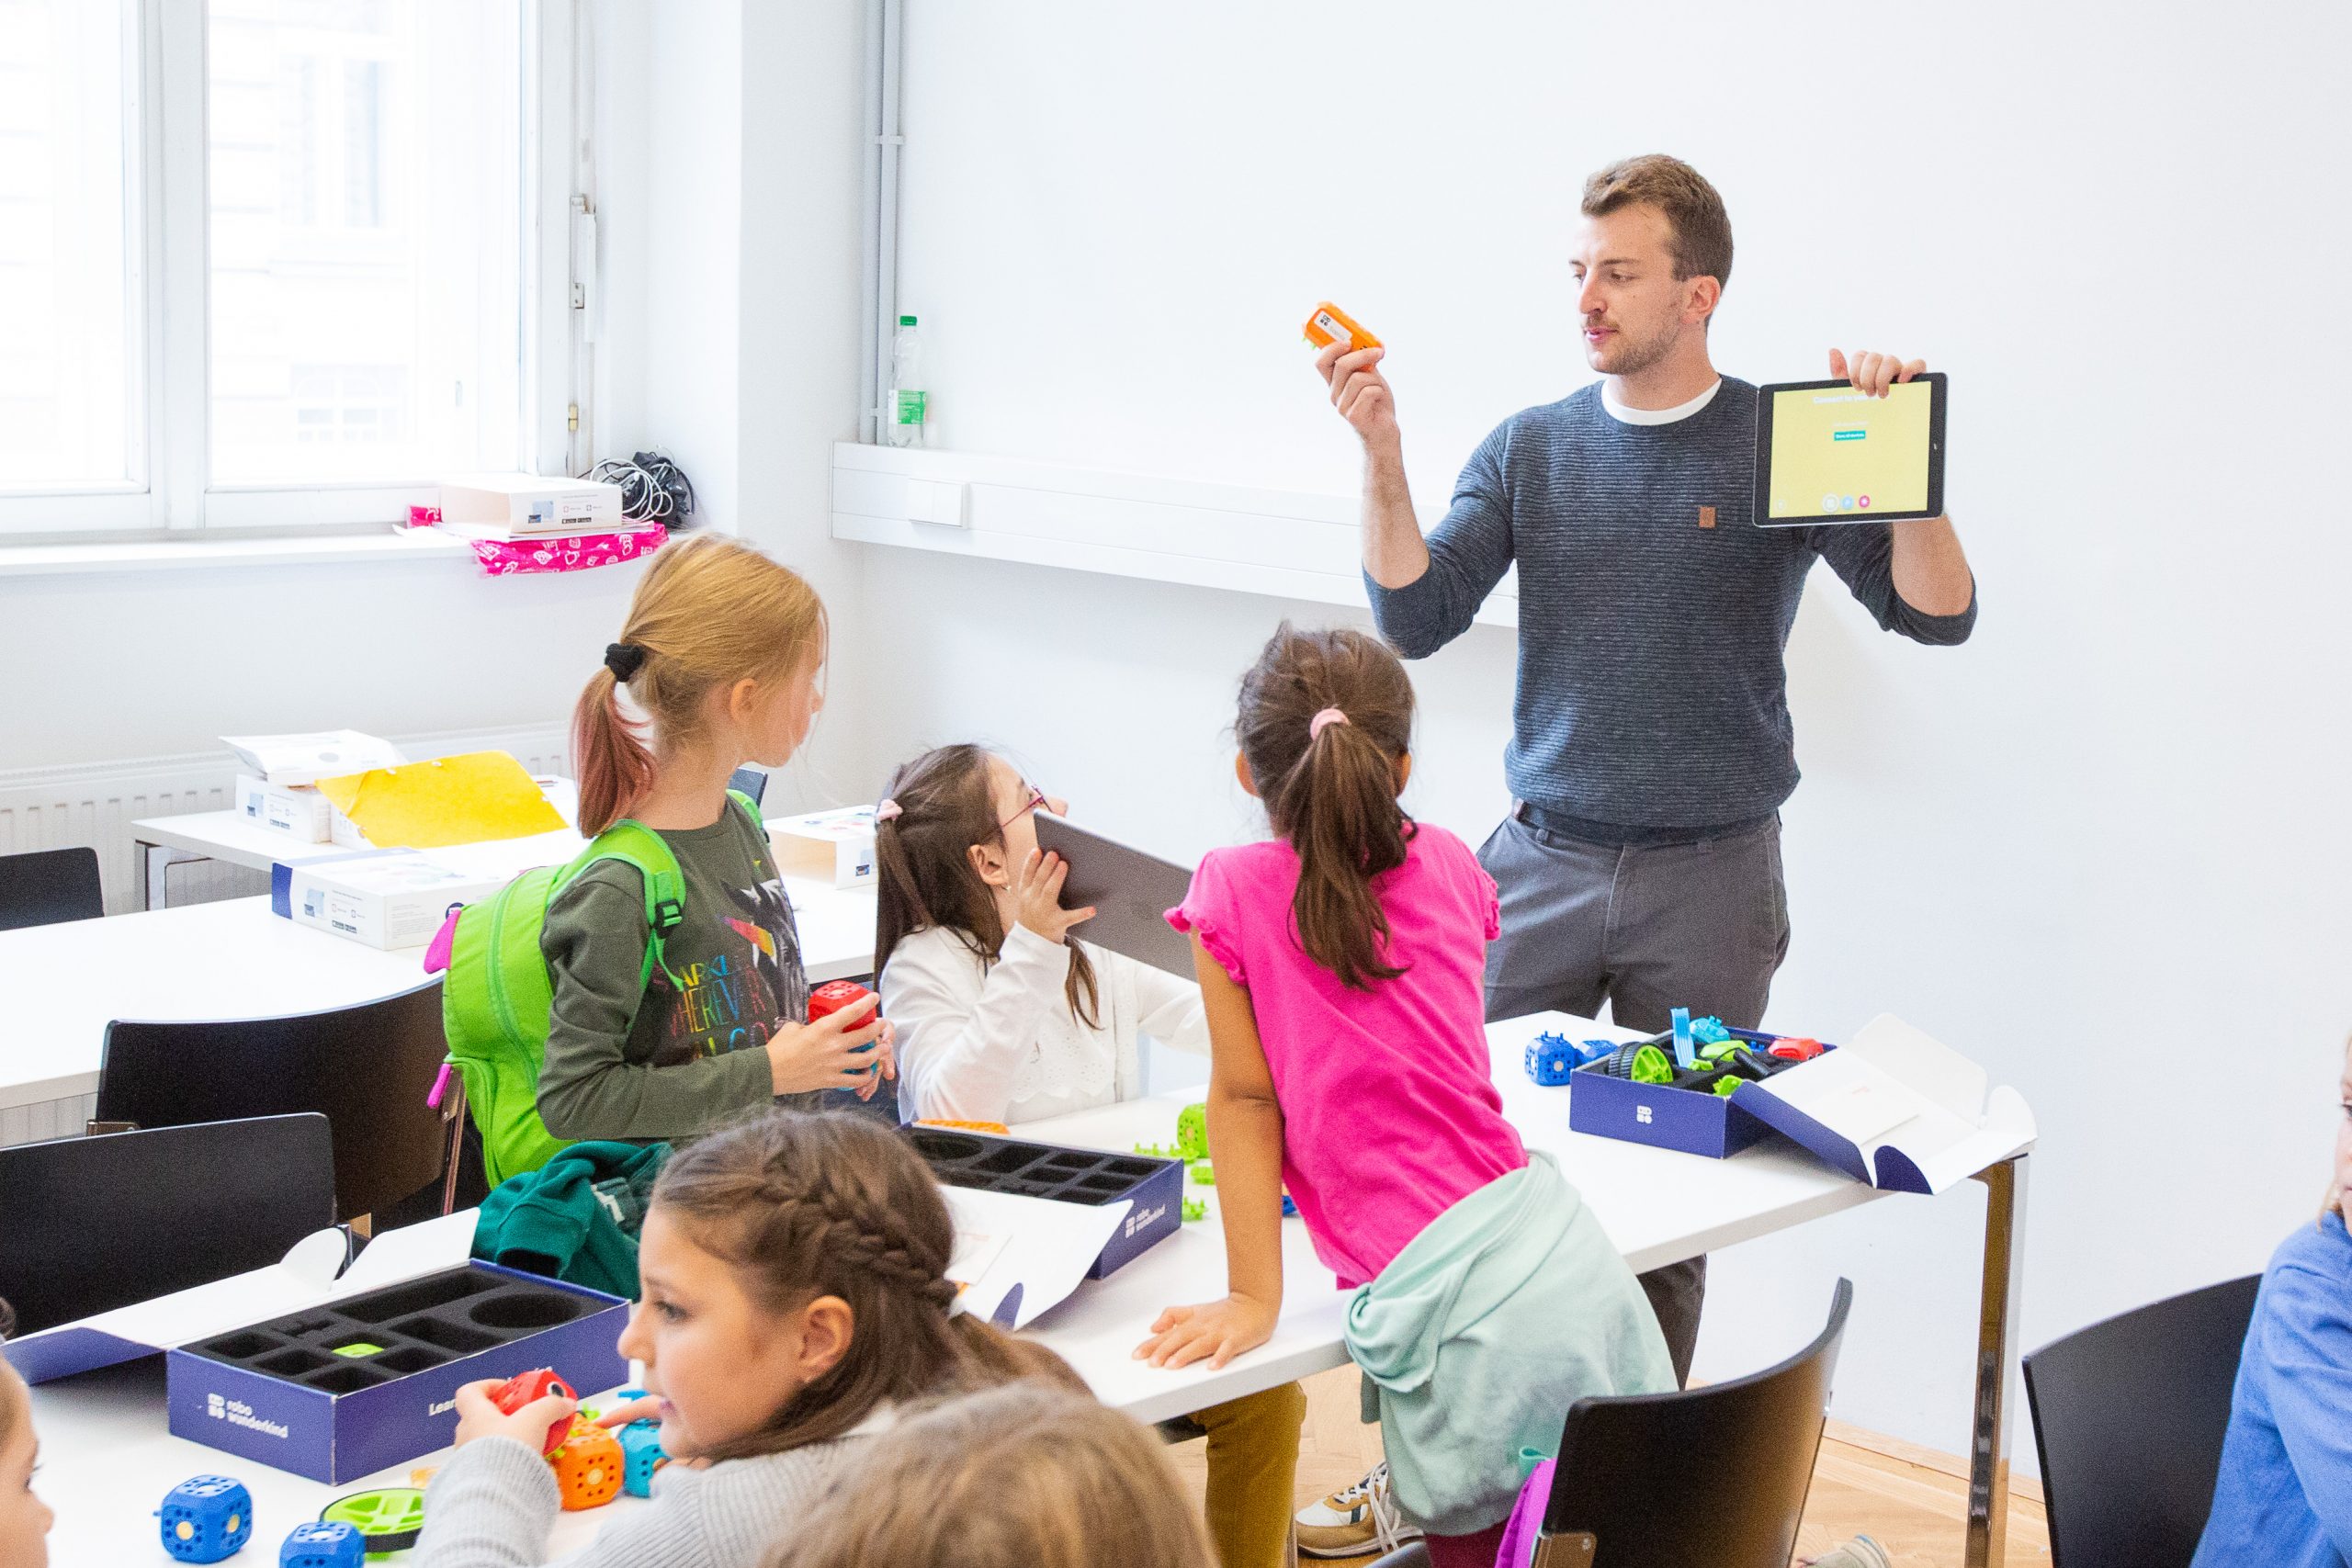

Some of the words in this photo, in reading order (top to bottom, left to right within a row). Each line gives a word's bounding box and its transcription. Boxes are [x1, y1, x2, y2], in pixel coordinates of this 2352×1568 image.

[226, 1400, 253, 1416] robo
[428, 1398, 457, 1416] Lear
[227, 1411, 288, 1439] wunderkind
